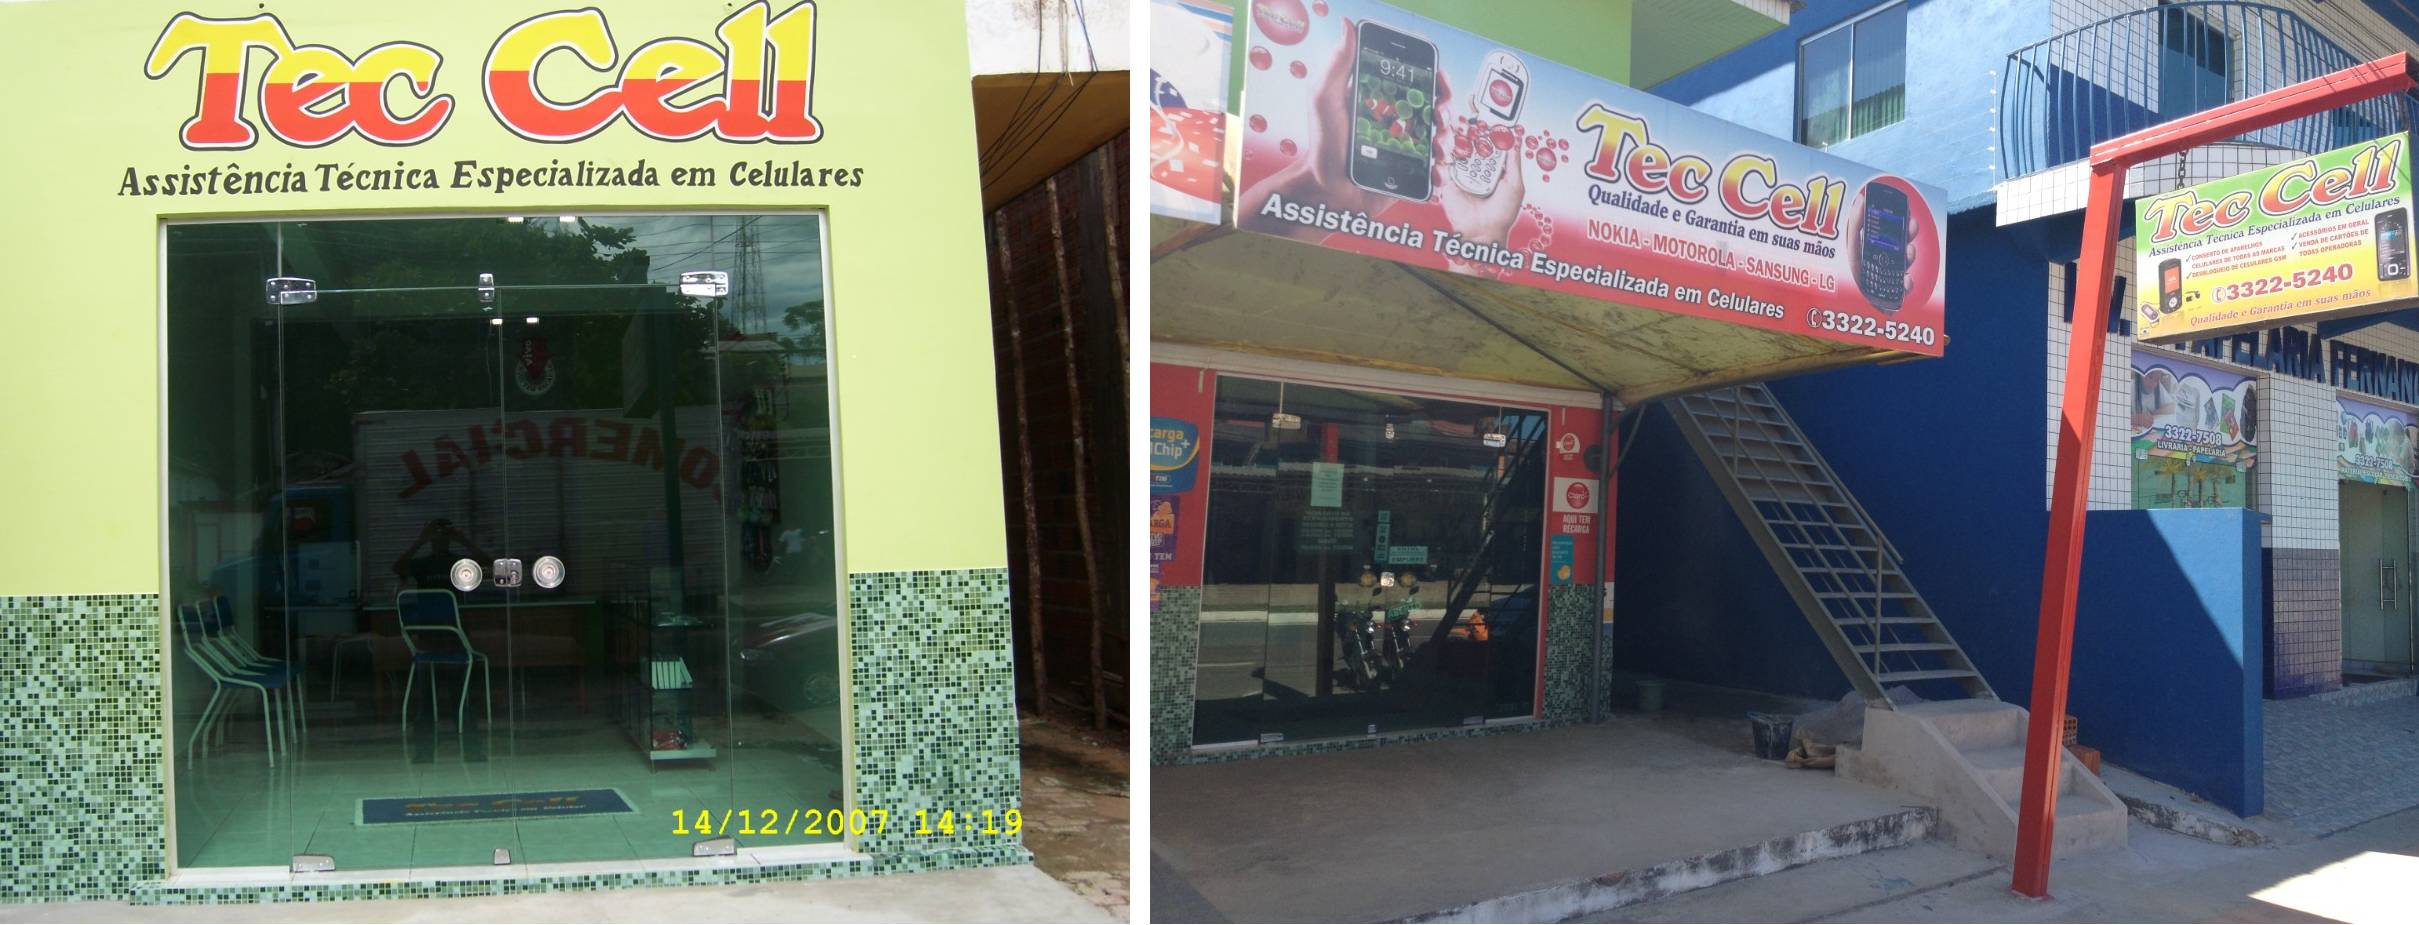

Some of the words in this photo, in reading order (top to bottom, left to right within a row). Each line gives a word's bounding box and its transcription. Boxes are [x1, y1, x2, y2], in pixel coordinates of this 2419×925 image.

[144, 11, 456, 150] Tec
[482, 0, 824, 145] Cell
[1379, 59, 1414, 82] 9:41
[118, 162, 308, 196] Assistência
[314, 160, 440, 192] Técnica
[451, 159, 660, 193] Especializada
[671, 165, 717, 188] em
[729, 160, 864, 188] Celulares
[1576, 104, 1712, 204] Tec
[1718, 154, 1847, 240] Cell
[2145, 191, 2252, 243] Tec
[2259, 139, 2401, 217] Cell
[1588, 184, 1669, 219] Qualidade
[1672, 209, 1681, 222] e
[1685, 209, 1745, 238] Garantia
[1749, 228, 1769, 244] em
[1772, 232, 1800, 251] suas
[1803, 239, 1836, 259] mãos
[2248, 213, 2322, 237] Especializada
[2325, 209, 2342, 219] em
[2345, 196, 2401, 214] Celulares
[2348, 219, 2369, 228] GERAL
[1261, 193, 1424, 249] Assistência
[1432, 229, 1525, 269] Técnica
[1530, 252, 1670, 298] Especializada
[1674, 284, 1702, 304] em
[1707, 288, 1785, 320] Celulares
[1588, 219, 1640, 248] NOKIA
[1653, 232, 1736, 269] MOTOROLA
[1746, 256, 1810, 286] SANSUNG
[1819, 273, 1836, 291] LG
[2260, 246, 2285, 255] MARCAS
[2226, 263, 2353, 301] 3322-5240
[2191, 308, 2239, 326] Qualidade
[2249, 301, 2294, 316] Garantia
[2296, 299, 2312, 308] em
[2314, 294, 2338, 304] suas
[2342, 288, 2372, 301] mãos
[1822, 310, 1935, 346] 3322-5240
[2165, 424, 2222, 446] 3322-7508
[1562, 514, 1577, 523] AQUI
[1578, 515, 1591, 524] TEM
[1562, 525, 1590, 534] RECARGA
